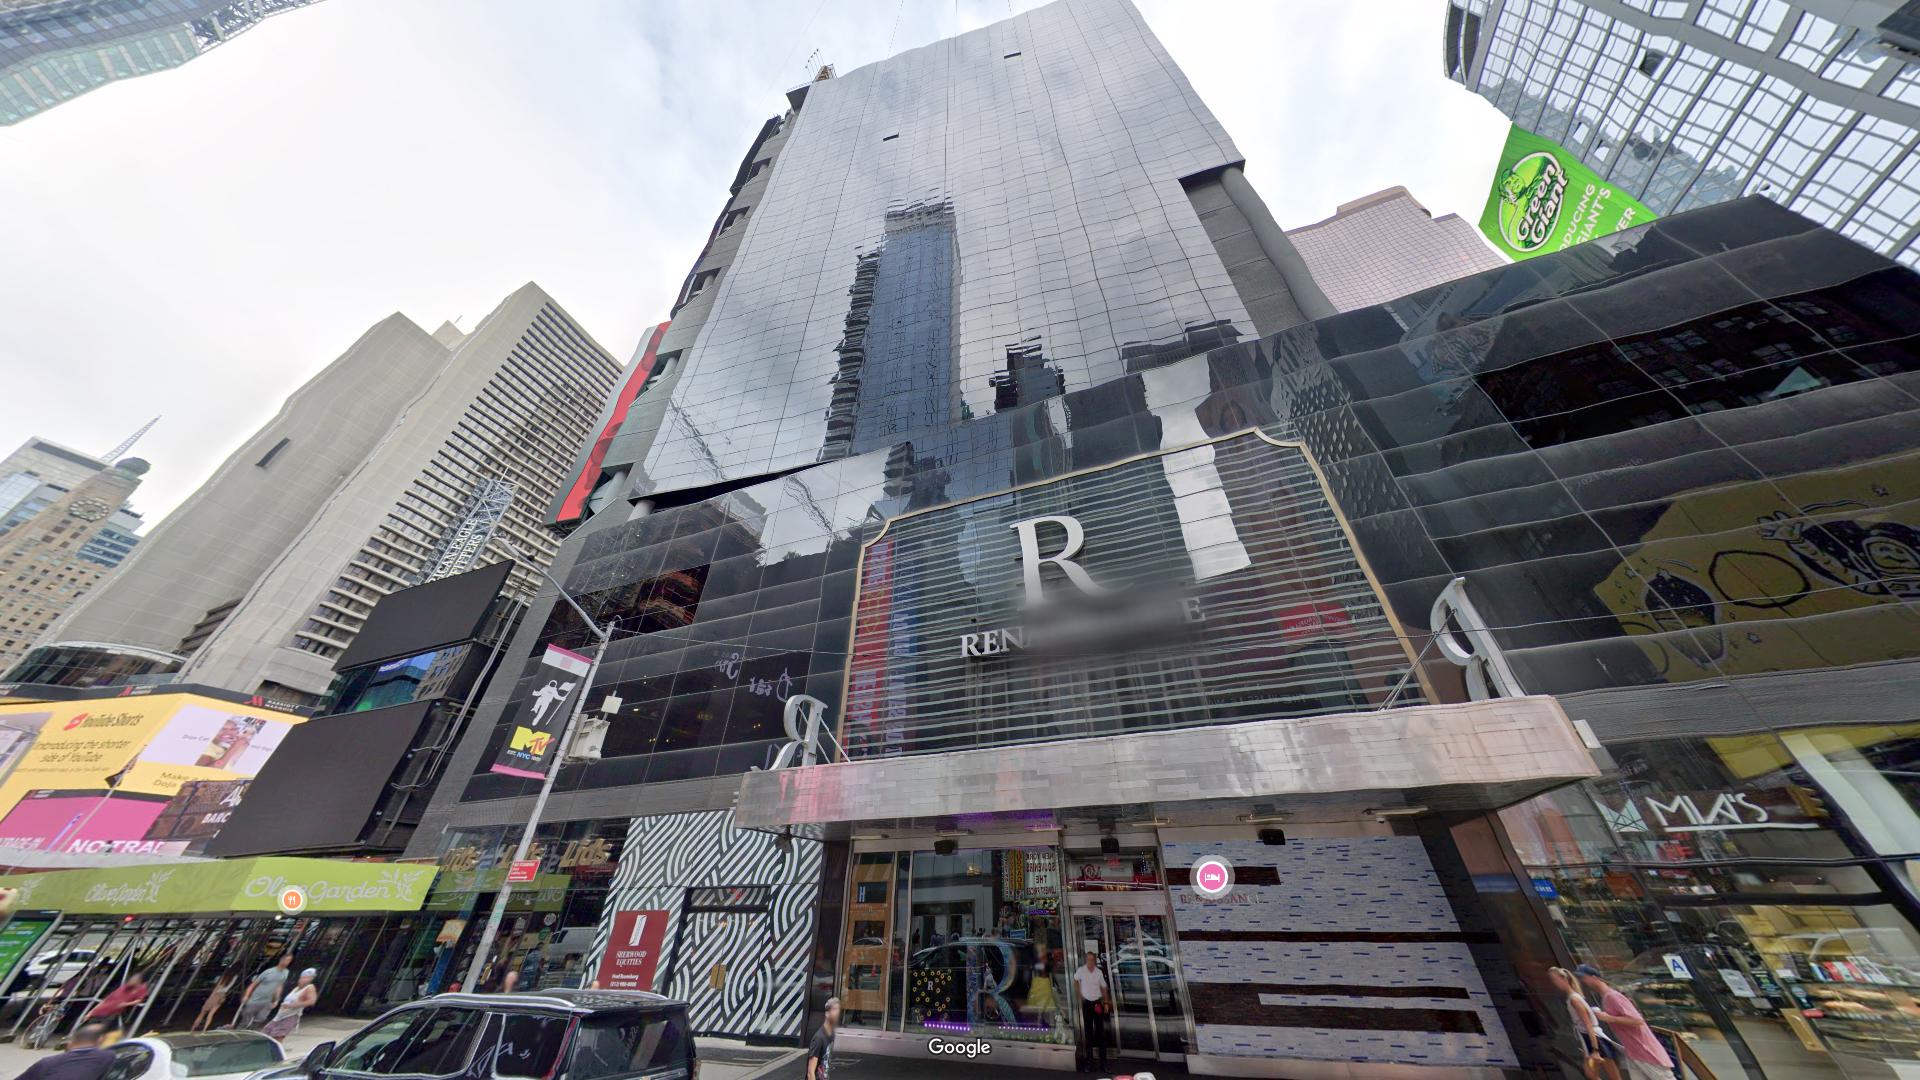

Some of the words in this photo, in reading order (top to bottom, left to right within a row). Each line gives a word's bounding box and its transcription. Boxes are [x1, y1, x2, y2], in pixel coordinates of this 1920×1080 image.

[1516, 164, 1558, 241] Green
[1531, 168, 1569, 244] Giant
[449, 518, 478, 550] EAGLE
[447, 533, 483, 576] FITTERS
[1010, 515, 1132, 604] R
[510, 726, 555, 756] MTV
[559, 837, 613, 869] Lids
[244, 875, 309, 900] Olie
[308, 879, 392, 905] Garden
[1671, 958, 1685, 972] A
